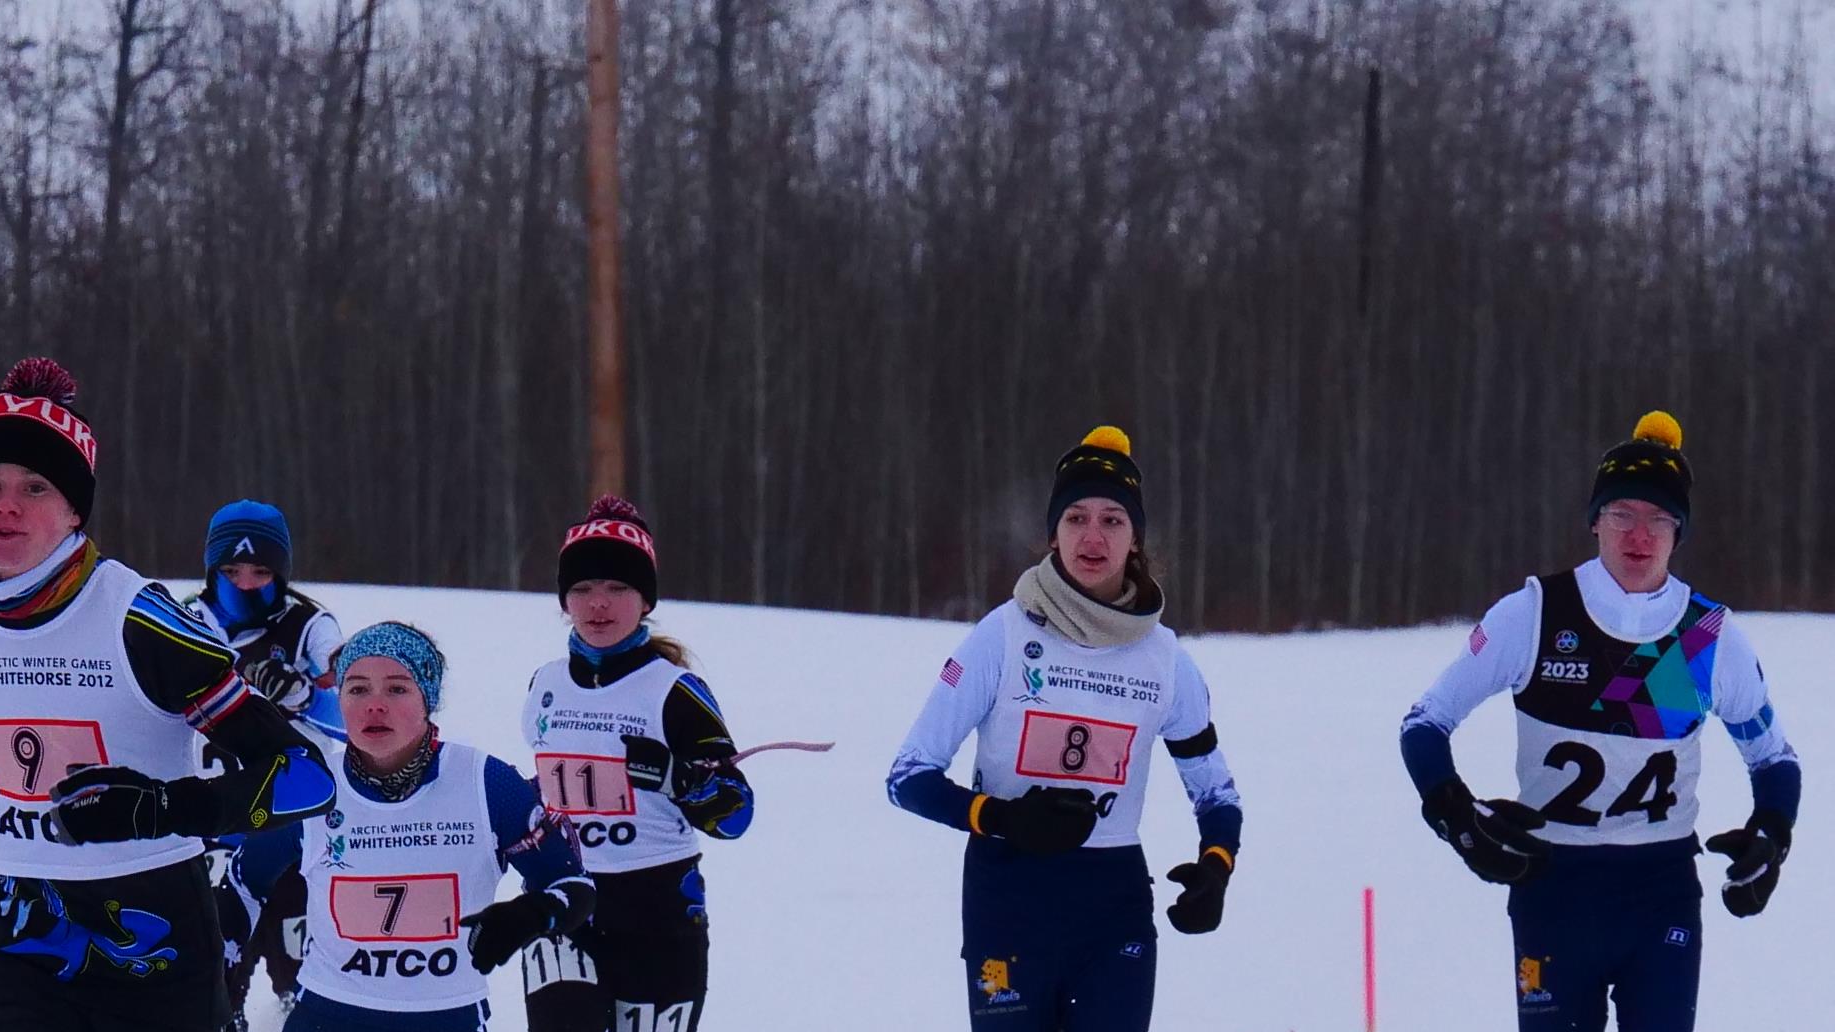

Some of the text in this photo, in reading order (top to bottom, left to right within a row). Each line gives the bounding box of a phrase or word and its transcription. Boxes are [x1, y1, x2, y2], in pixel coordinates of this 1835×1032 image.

[22, 656, 67, 669] WINTER
[70, 658, 112, 671] GAMES
[1540, 661, 1590, 680] 2023
[78, 673, 114, 688] 2012
[1047, 664, 1161, 691] ARCTIC WINTER GAMES
[1047, 676, 1159, 704] WHITEHORSE 2012
[553, 709, 648, 726] ARCTIC WINTER GAMES
[550, 719, 646, 736] WHITEHORSE 2012
[1060, 722, 1093, 774] 8
[11, 726, 45, 795] 9
[1114, 760, 1121, 779] 1
[551, 759, 598, 811] 11
[1539, 740, 1678, 827] 24
[618, 793, 627, 811] 1
[350, 821, 475, 835] ARCTIC WINTER GAMES
[349, 833, 475, 849] WHITEHORSE 2012
[374, 883, 408, 936] 7
[442, 916, 452, 934] 1
[340, 947, 458, 978] ATCO
